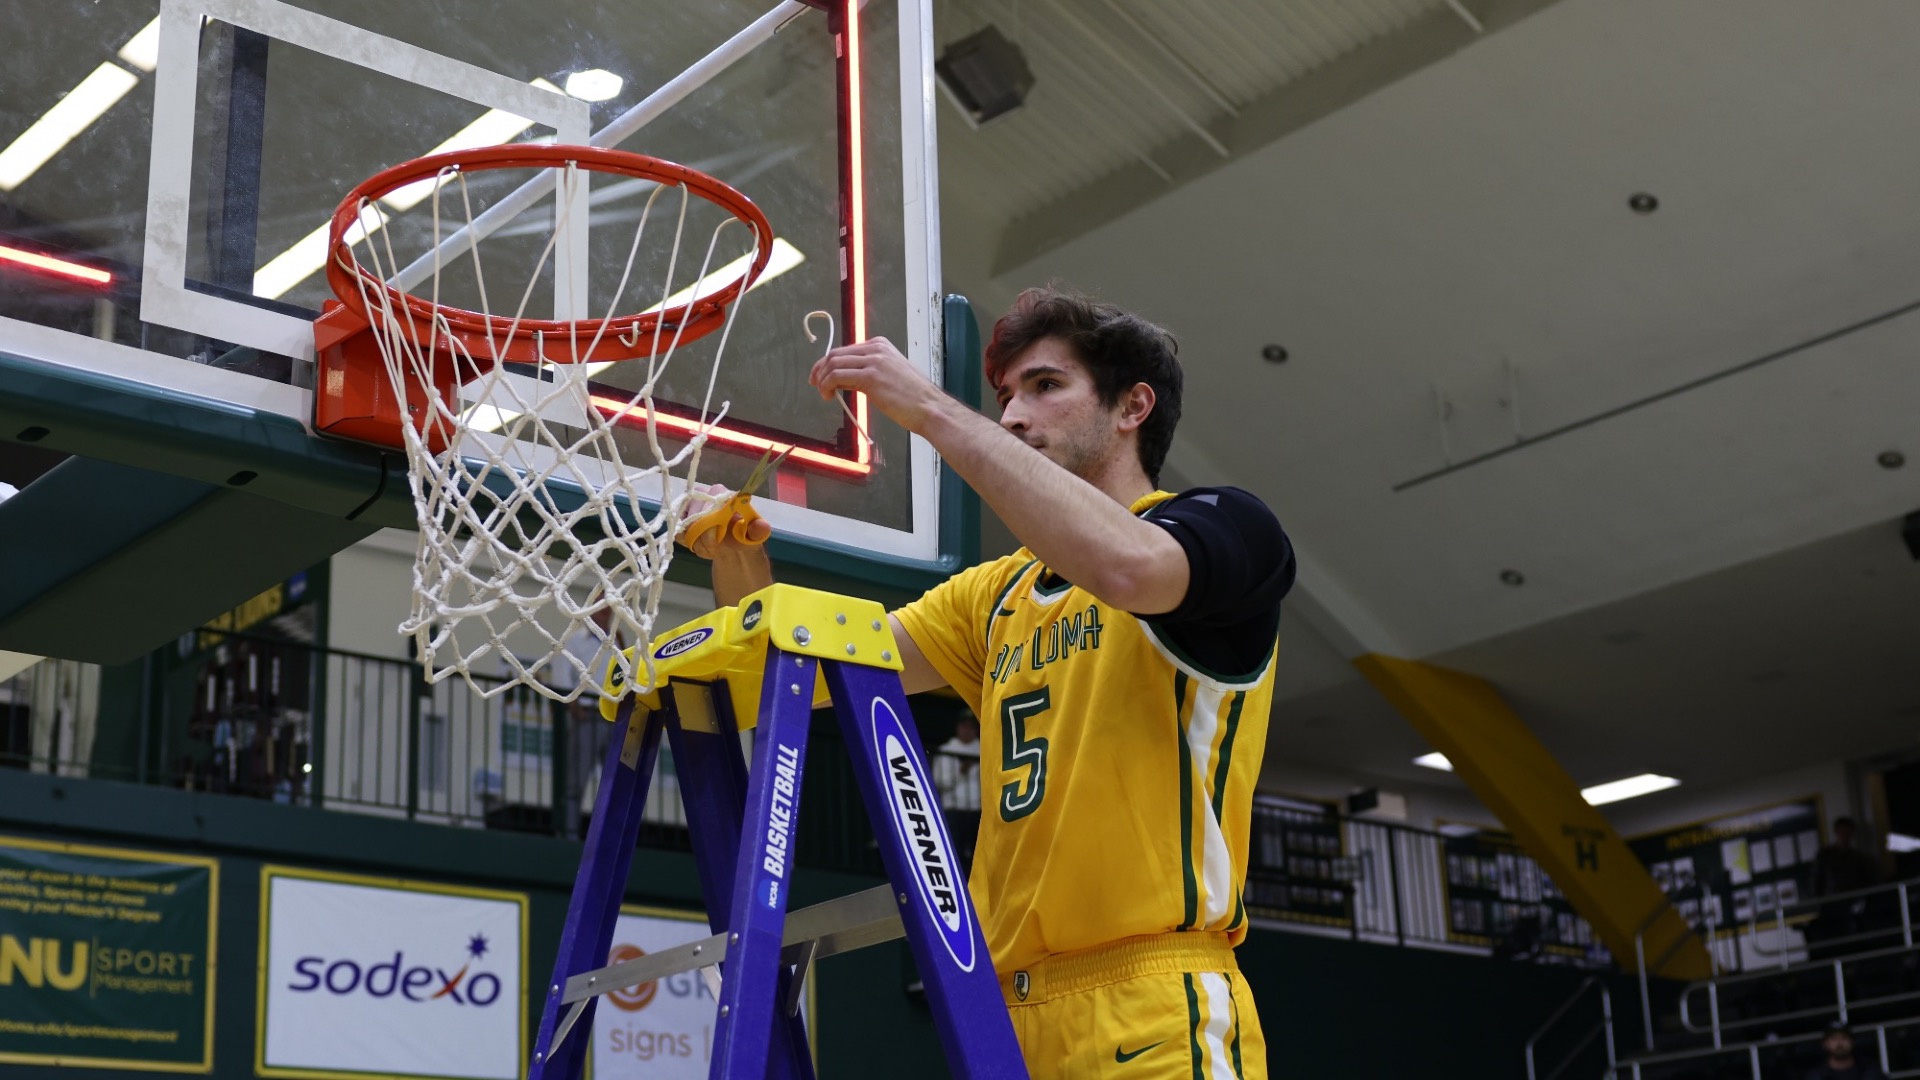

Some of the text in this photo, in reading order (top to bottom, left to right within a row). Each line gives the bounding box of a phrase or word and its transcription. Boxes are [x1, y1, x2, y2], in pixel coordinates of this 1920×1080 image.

[743, 611, 762, 626] NCAA
[665, 632, 703, 655] WERNER
[1000, 685, 1051, 823] 5
[763, 743, 799, 879] BASKETBALL
[889, 754, 957, 916] WERNER
[1576, 841, 1600, 872] H
[768, 880, 779, 909] NCAA
[97, 947, 194, 976] SPORT
[96, 972, 193, 996] Management
[288, 950, 502, 1007] sodexo
[609, 1022, 694, 1061] signs
